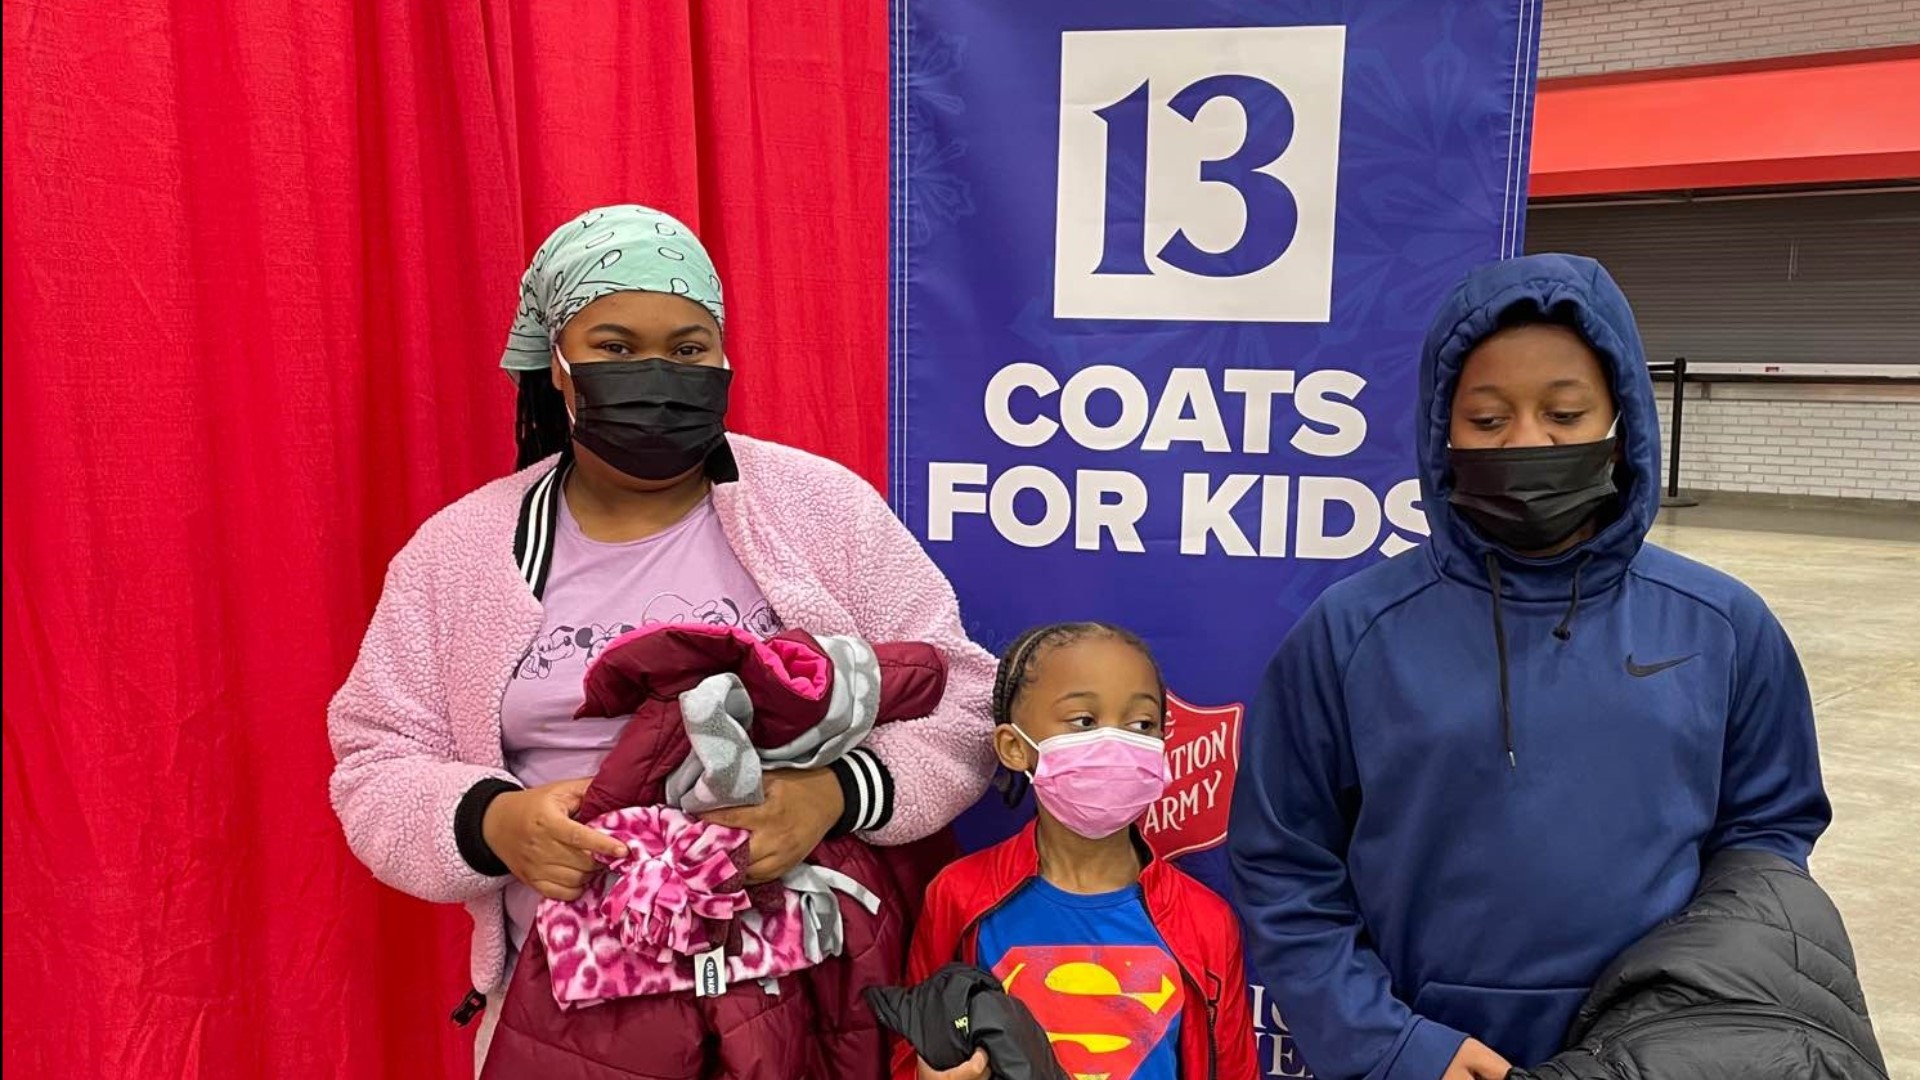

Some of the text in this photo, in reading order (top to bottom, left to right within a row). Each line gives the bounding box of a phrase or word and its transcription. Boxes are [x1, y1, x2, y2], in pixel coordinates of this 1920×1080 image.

[1091, 74, 1299, 278] 13
[984, 362, 1368, 457] COATS
[927, 461, 1432, 561] FOR KIDS
[1143, 769, 1223, 837] ARMY
